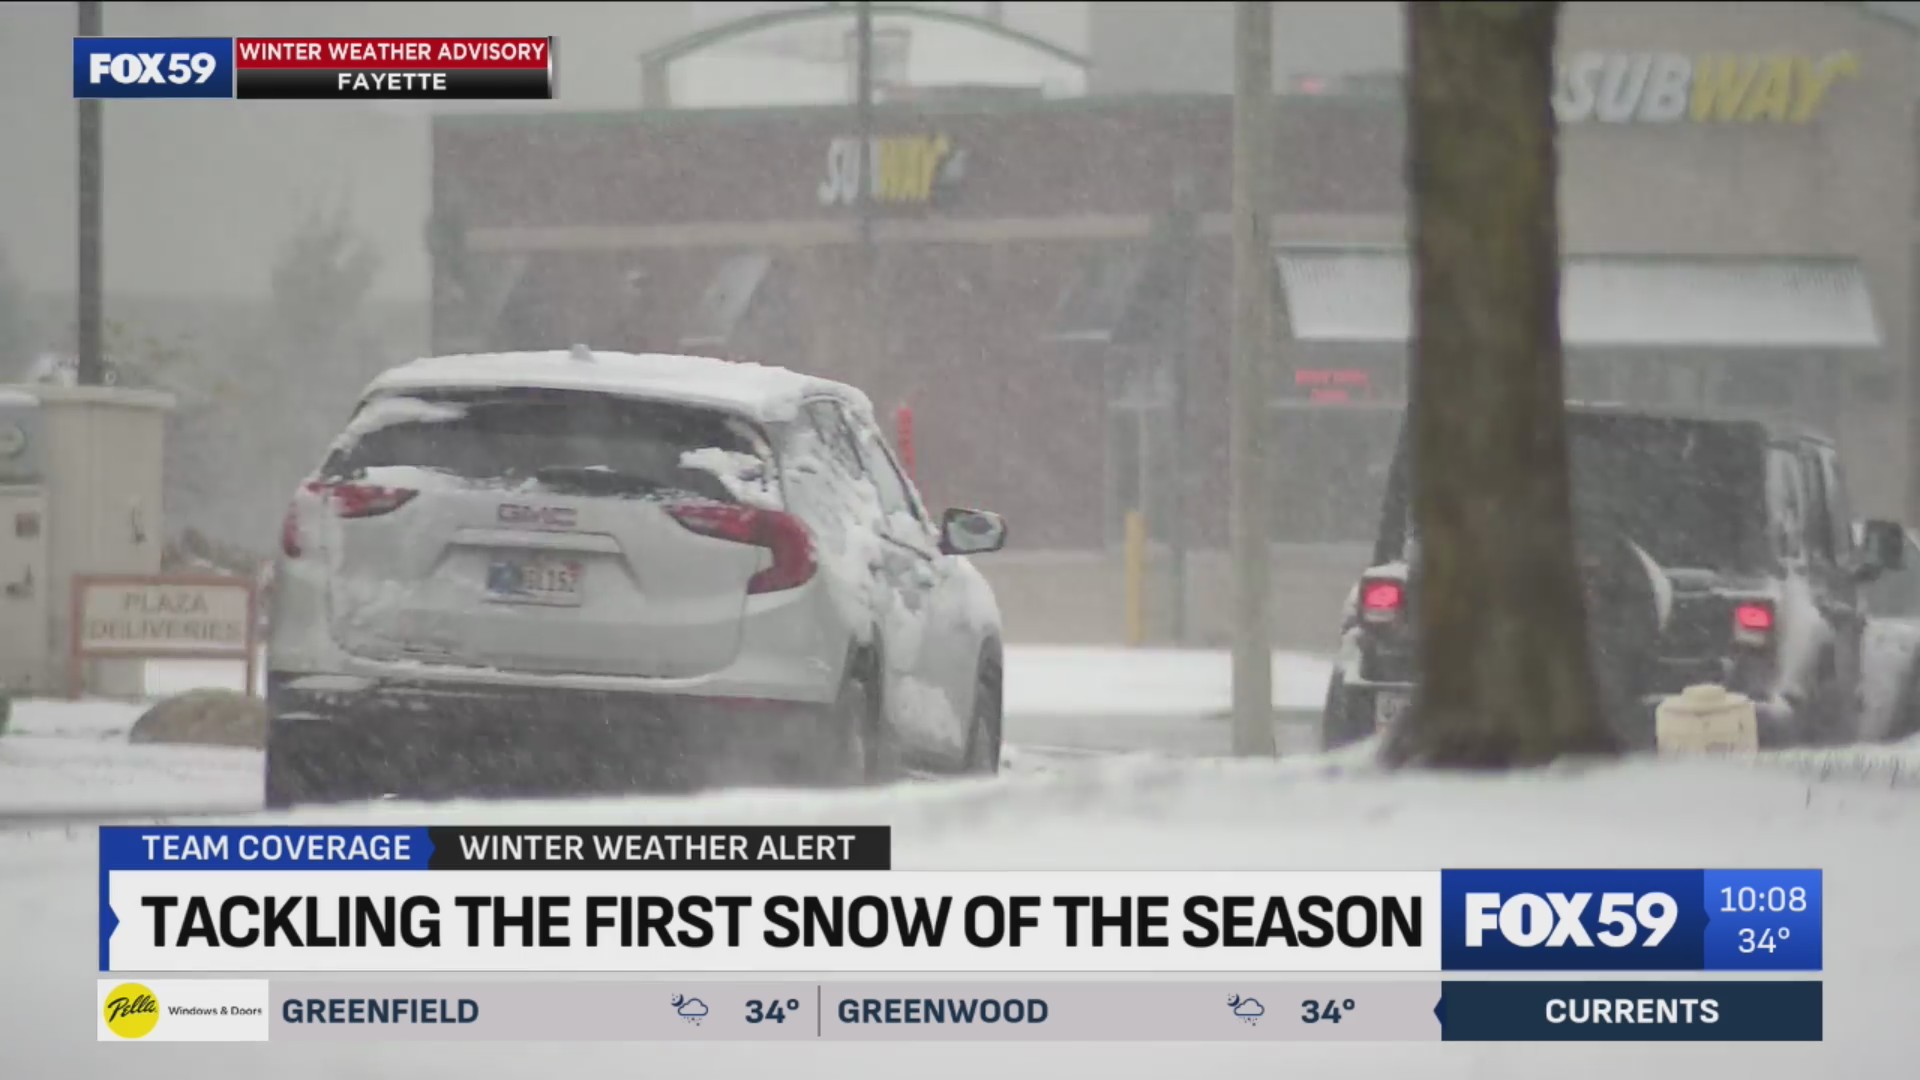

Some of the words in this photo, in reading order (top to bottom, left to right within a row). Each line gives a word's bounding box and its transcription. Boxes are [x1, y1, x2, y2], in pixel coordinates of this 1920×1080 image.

[1551, 51, 1860, 124] SUBWAY
[498, 503, 577, 528] GMC
[123, 592, 209, 614] PLAZA
[89, 619, 245, 641] DELIVERIES
